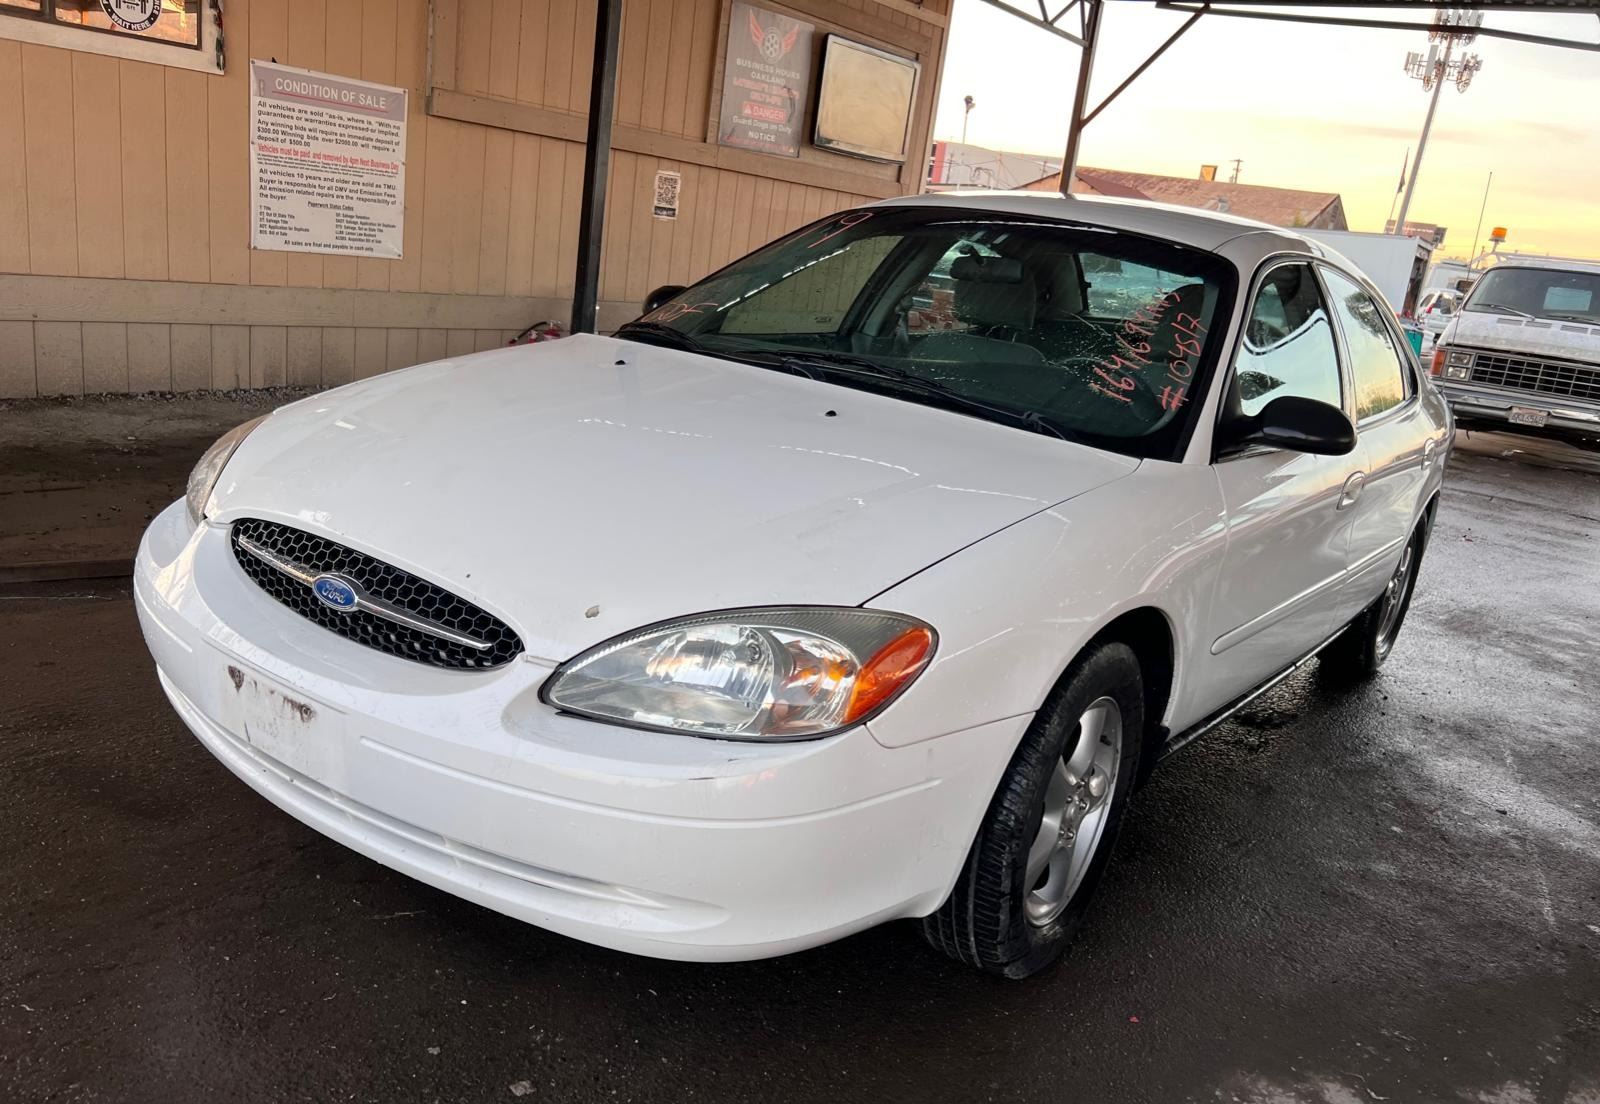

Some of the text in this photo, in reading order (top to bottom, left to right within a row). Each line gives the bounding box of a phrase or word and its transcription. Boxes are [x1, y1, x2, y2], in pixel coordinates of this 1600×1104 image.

[112, 13, 150, 30] WAIT HERE
[737, 58, 800, 79] BUSINESS HOURS
[751, 71, 786, 85] OAKLAND
[275, 78, 386, 109] CONDITION OF SALE
[269, 103, 295, 113] vehicles
[753, 106, 784, 120] DANGER
[258, 109, 294, 120] guarantees
[304, 116, 336, 126] warranties
[338, 123, 369, 132] expressed
[378, 129, 400, 137] implied.
[733, 115, 752, 126] Guard
[753, 120, 768, 129] Dogs
[779, 124, 792, 135] Duty
[257, 126, 279, 135] $300.00
[281, 130, 304, 140] Winning
[257, 134, 279, 143] deposit
[258, 118, 268, 126] Any
[271, 121, 293, 130] winning
[319, 129, 338, 137] require
[347, 133, 373, 142] immediate
[375, 137, 393, 146] deposit
[748, 130, 776, 142] NOTICE
[258, 143, 278, 154] Vehicles
[300, 150, 310, 159] paid
[343, 155, 348, 165] by
[360, 158, 369, 166] Next
[371, 160, 390, 169] Business
[270, 170, 295, 178] vehicles
[284, 180, 316, 189] responsible
[357, 196, 390, 206] responsibility
[322, 581, 346, 604] Ford
